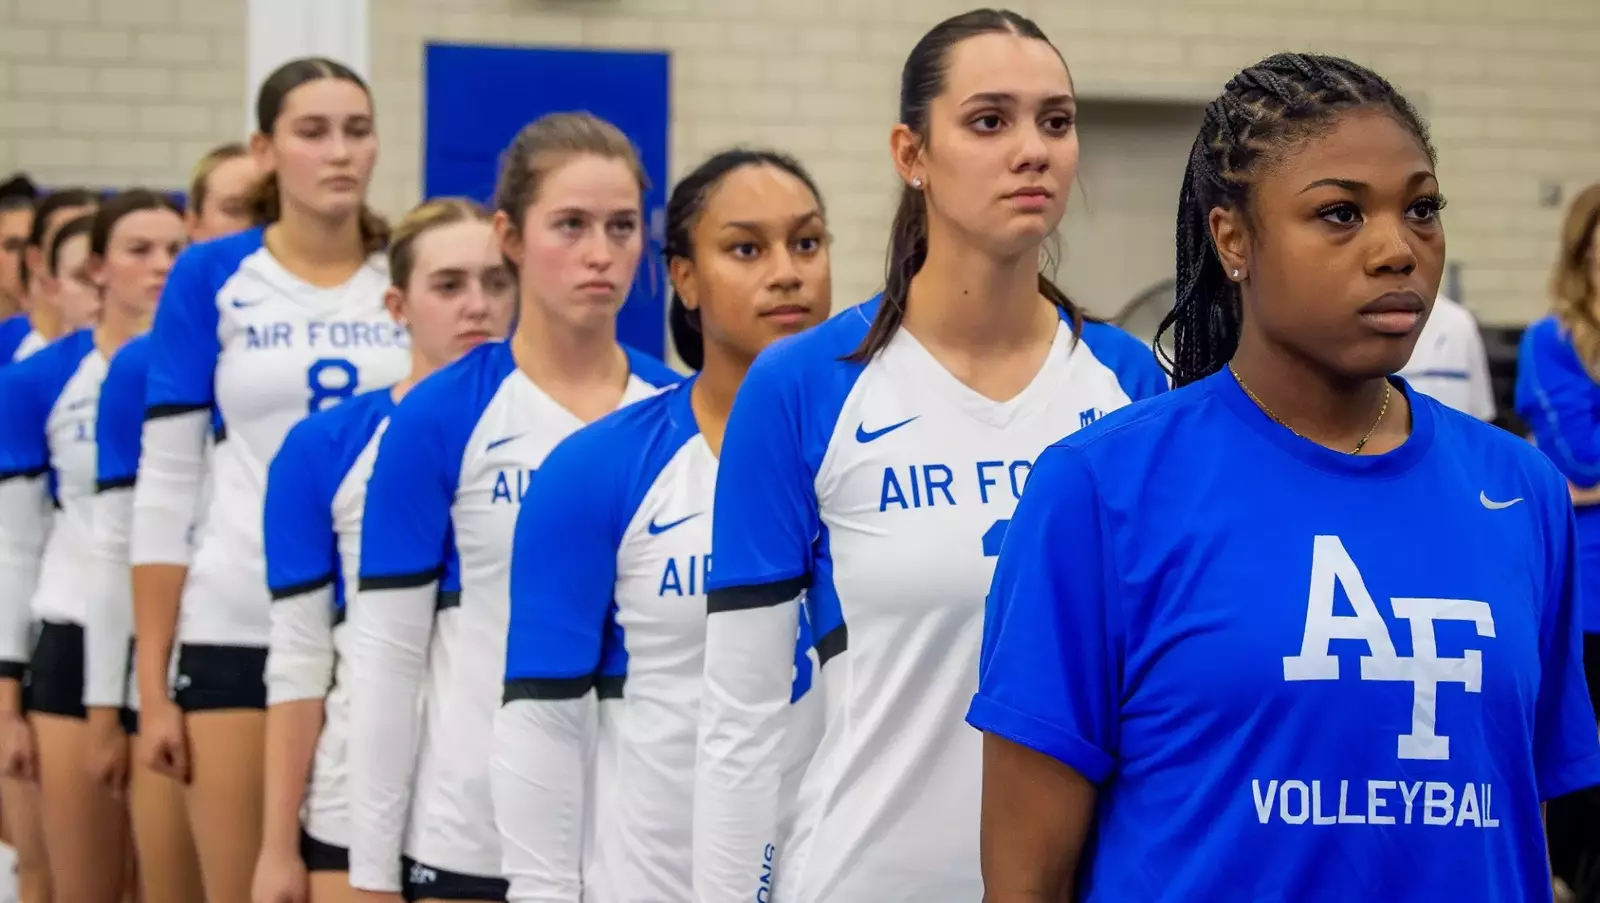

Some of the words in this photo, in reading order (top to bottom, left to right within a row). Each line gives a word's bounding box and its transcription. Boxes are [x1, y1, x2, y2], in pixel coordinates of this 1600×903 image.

[246, 322, 293, 350] AIR
[308, 358, 358, 414] 8
[879, 464, 957, 512] AIR
[1283, 535, 1496, 760] AF
[1252, 779, 1500, 828] VOLLEYBALL
